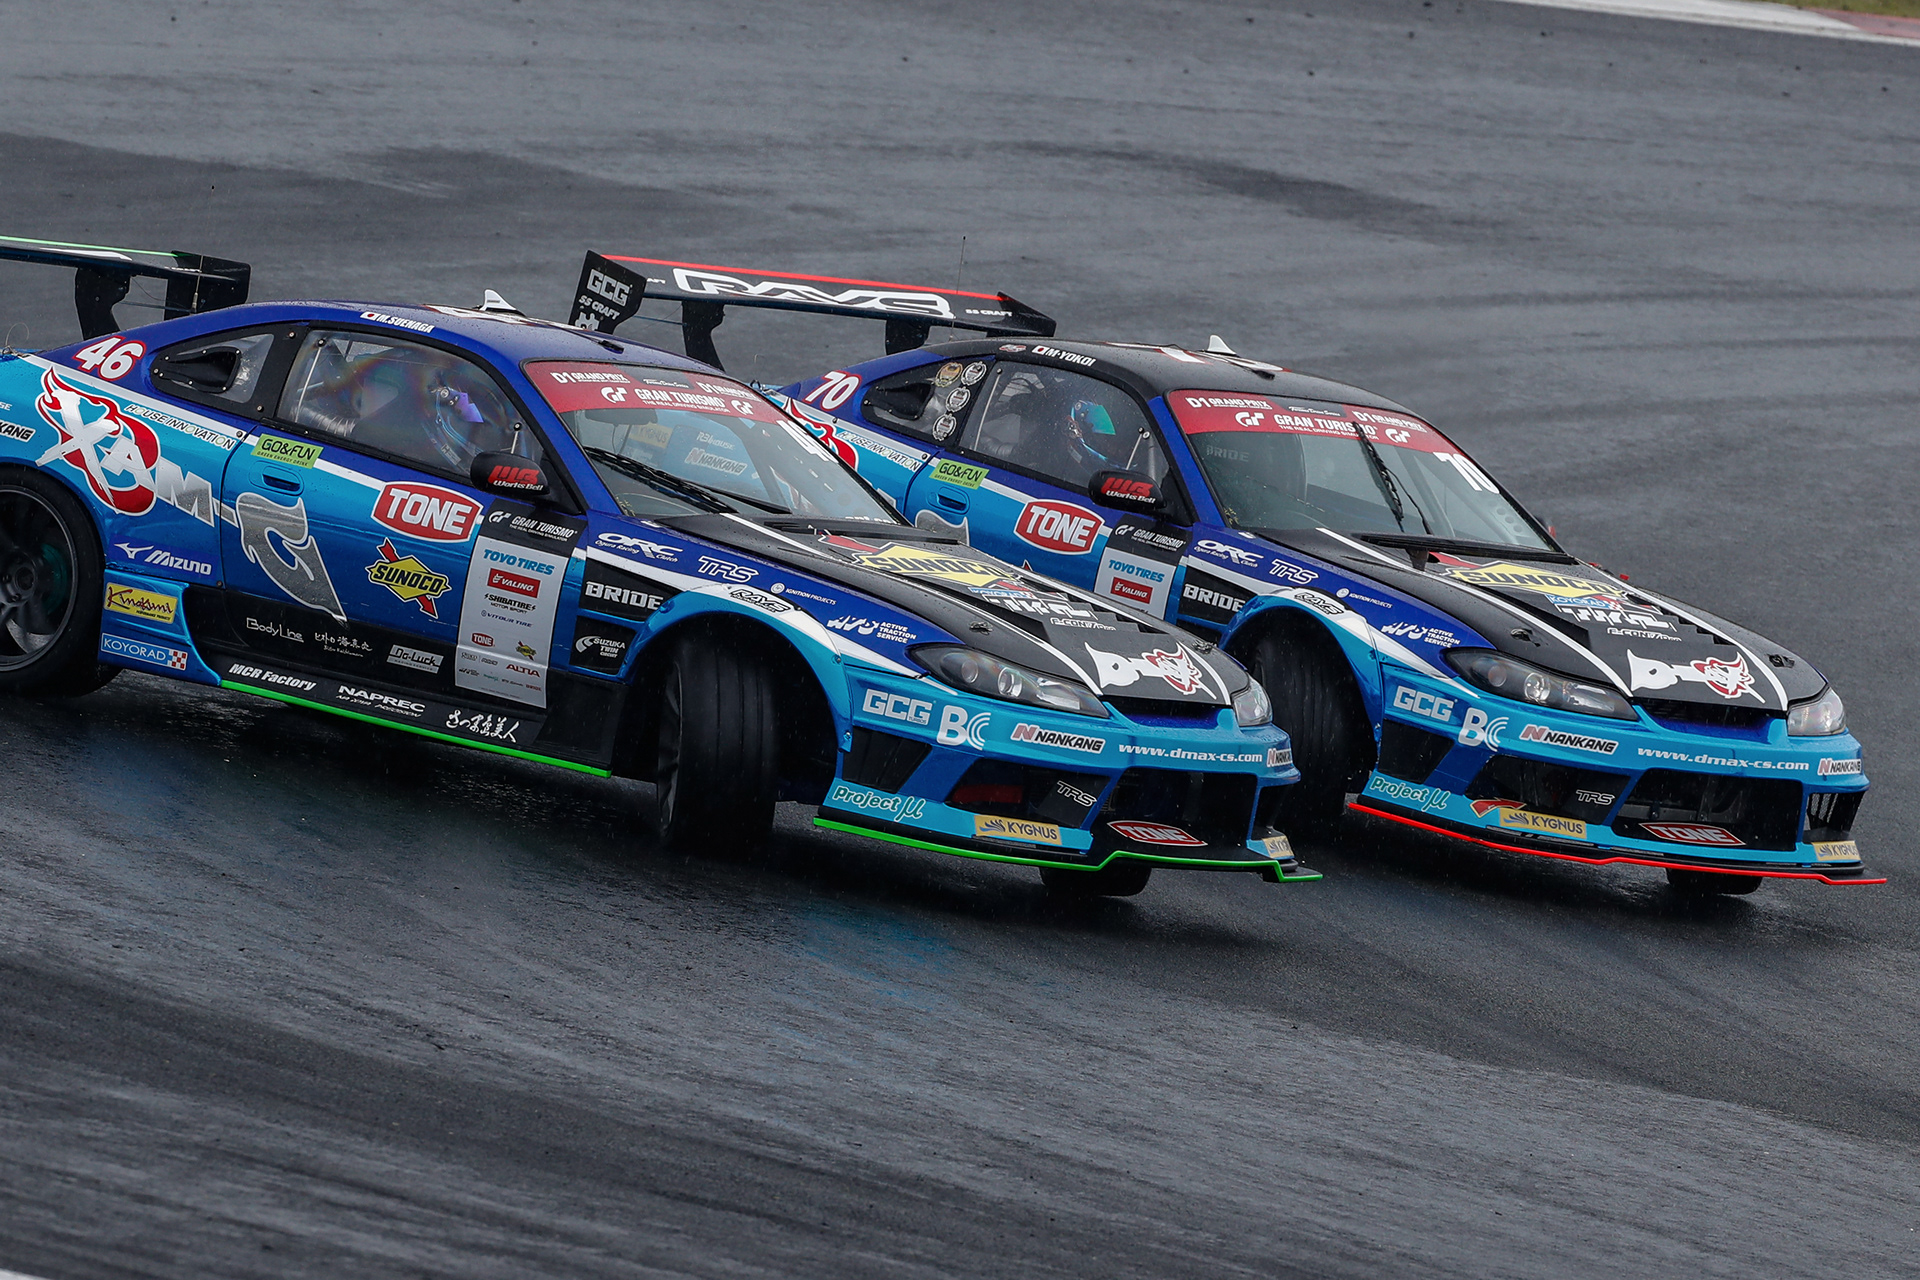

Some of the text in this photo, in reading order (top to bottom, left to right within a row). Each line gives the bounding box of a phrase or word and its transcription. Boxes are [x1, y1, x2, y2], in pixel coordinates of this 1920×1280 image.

[587, 269, 630, 307] GCG
[579, 295, 620, 320] SS CRAFT
[980, 309, 1012, 317] CRAFT
[375, 313, 435, 333] M.SUENAGA
[75, 336, 145, 380] 46
[634, 388, 672, 402] GRAN
[669, 391, 726, 408] TURISMO
[804, 371, 860, 410] 70
[125, 404, 235, 450] HOUSE INNOVATION
[1273, 414, 1314, 428] GRAN
[261, 439, 316, 460] GO&FUN
[838, 431, 924, 472] HOUSE INNOVATION
[700, 453, 746, 474] NANKANG
[938, 462, 983, 482] GO&FUN
[1433, 452, 1500, 495] 70
[493, 480, 544, 491] Works Bell
[1106, 490, 1157, 504] Works Bell
[387, 487, 473, 536] TONE
[511, 516, 538, 529] GRAN
[536, 522, 574, 538] TURISMO
[1026, 505, 1096, 548] TONE
[598, 532, 684, 559] ORC
[1133, 528, 1155, 540] GRAN
[1152, 533, 1184, 549] TURISMO
[484, 549, 555, 576] TOYO TIRES
[1197, 540, 1264, 564] ORC
[374, 565, 446, 594] SUNOCO
[698, 556, 759, 583] TRS
[1108, 559, 1165, 583] TOYO TIRES
[1268, 559, 1319, 585] TRS
[501, 576, 534, 592] VALINO
[1121, 585, 1149, 598] VALINO
[488, 594, 532, 610] SHIBATIRE
[585, 581, 664, 611] BRIDE
[785, 588, 837, 606] IGNITION PROJECTS
[1183, 583, 1246, 613] BRIDE
[473, 634, 492, 646] TONE
[593, 638, 625, 649] SUZUKA
[876, 621, 917, 644] ACTIVE TRACTION SERVICE
[1424, 627, 1460, 648] ACTIVE TRACTION SERVICE
[104, 638, 166, 661] KOYORAD
[229, 663, 316, 691] MCR Factory
[506, 664, 540, 678] ALTIA
[338, 685, 425, 712] NAPREC
[862, 688, 933, 725] GCG
[1393, 685, 1455, 722] GCG
[1035, 730, 1104, 751] NANKANG
[1542, 732, 1617, 753] NANKANG
[1118, 744, 1263, 763] www.dmax-cs.com
[1637, 748, 1810, 771] www.dmax-cs.com
[1057, 780, 1097, 807] TRS
[1576, 789, 1616, 805] TRS
[1007, 821, 1058, 841] KYGNUS
[1117, 824, 1192, 843] TONE
[1531, 815, 1584, 835] KYGNUS
[1650, 825, 1729, 844] TONE
